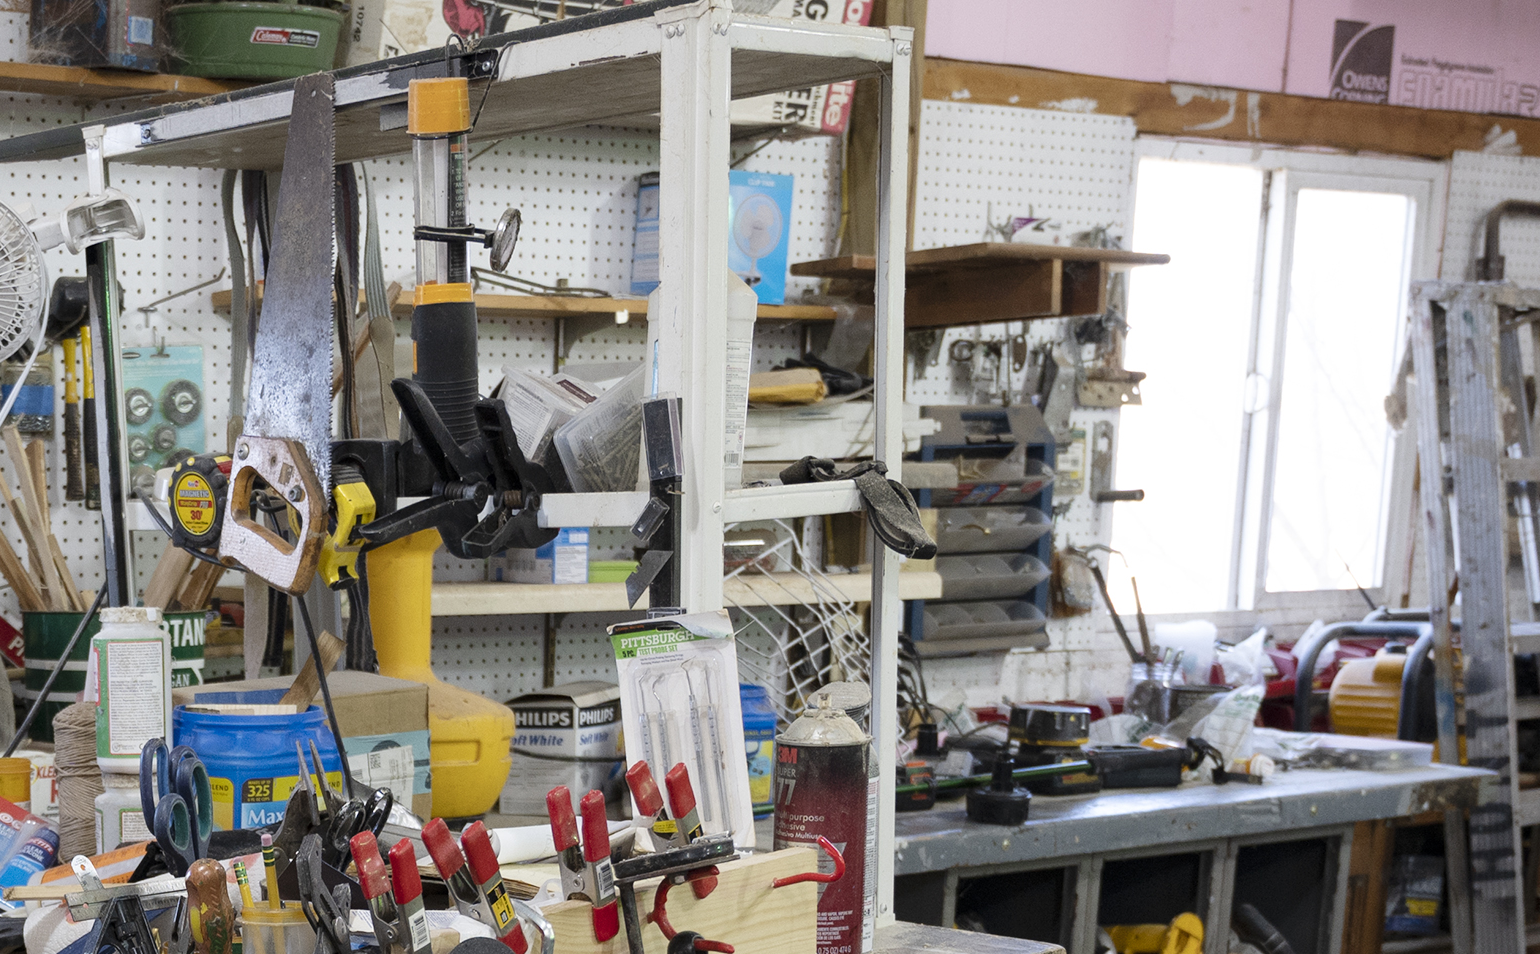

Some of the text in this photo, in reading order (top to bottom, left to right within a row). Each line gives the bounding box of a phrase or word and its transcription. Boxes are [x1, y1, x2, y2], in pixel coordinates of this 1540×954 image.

[353, 6, 365, 42] 10742
[1342, 70, 1388, 93] OWENS
[179, 490, 210, 498] MAGNETIC
[190, 510, 203, 520] 30'
[620, 630, 695, 649] PITTSBURGH
[622, 650, 626, 658] 5
[638, 647, 652, 656] TEST
[651, 646, 668, 655] PROBE
[668, 644, 678, 653] SET
[515, 712, 570, 727] HILIPS
[579, 707, 614, 726] PHILIPS
[511, 735, 564, 747] oft White
[579, 732, 609, 746] Soft White
[778, 747, 798, 765] 3M
[210, 783, 229, 792] LEND
[247, 784, 270, 798] 325
[777, 778, 797, 806] 77
